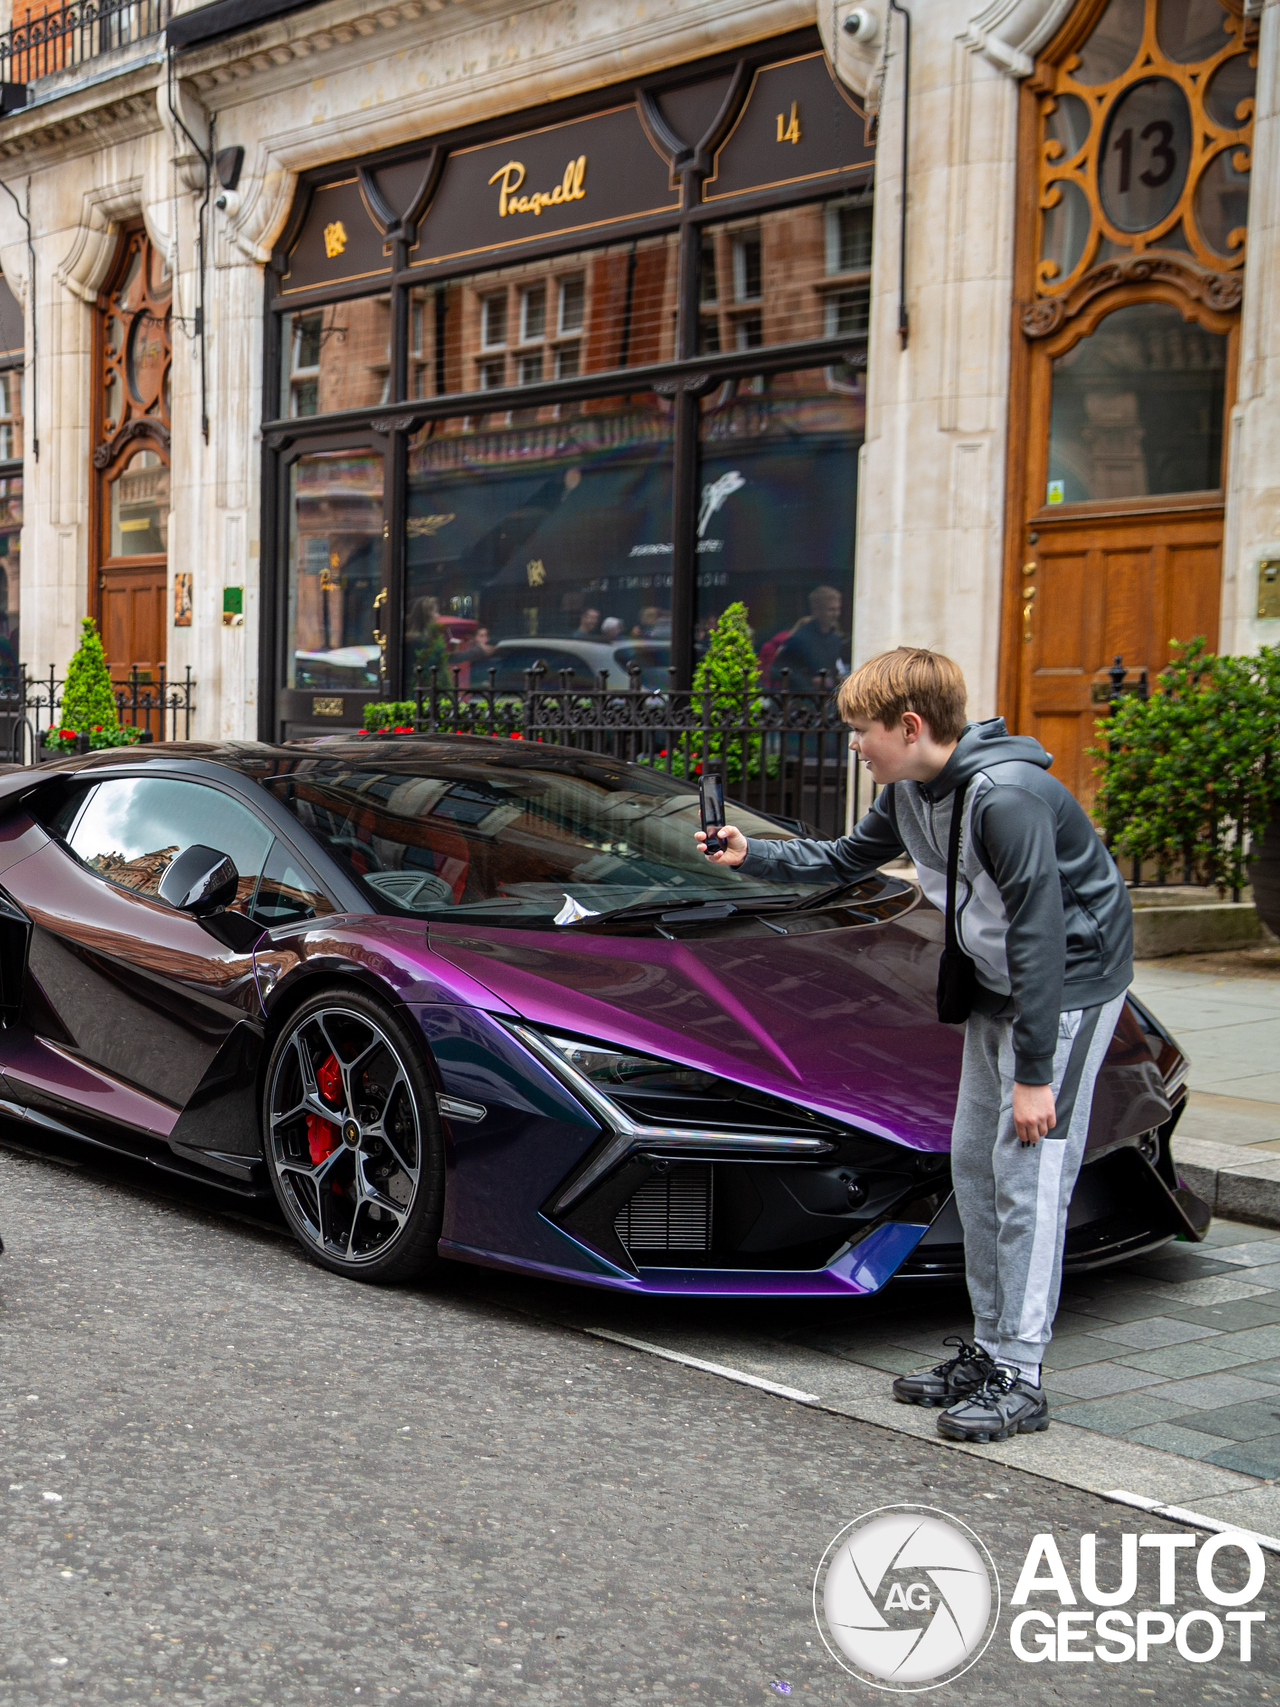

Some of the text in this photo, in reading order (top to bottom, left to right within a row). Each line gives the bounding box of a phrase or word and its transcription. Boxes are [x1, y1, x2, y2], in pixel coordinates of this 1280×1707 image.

[776, 100, 802, 144] 14
[488, 154, 586, 217] Pragnell
[1114, 120, 1177, 194] 13
